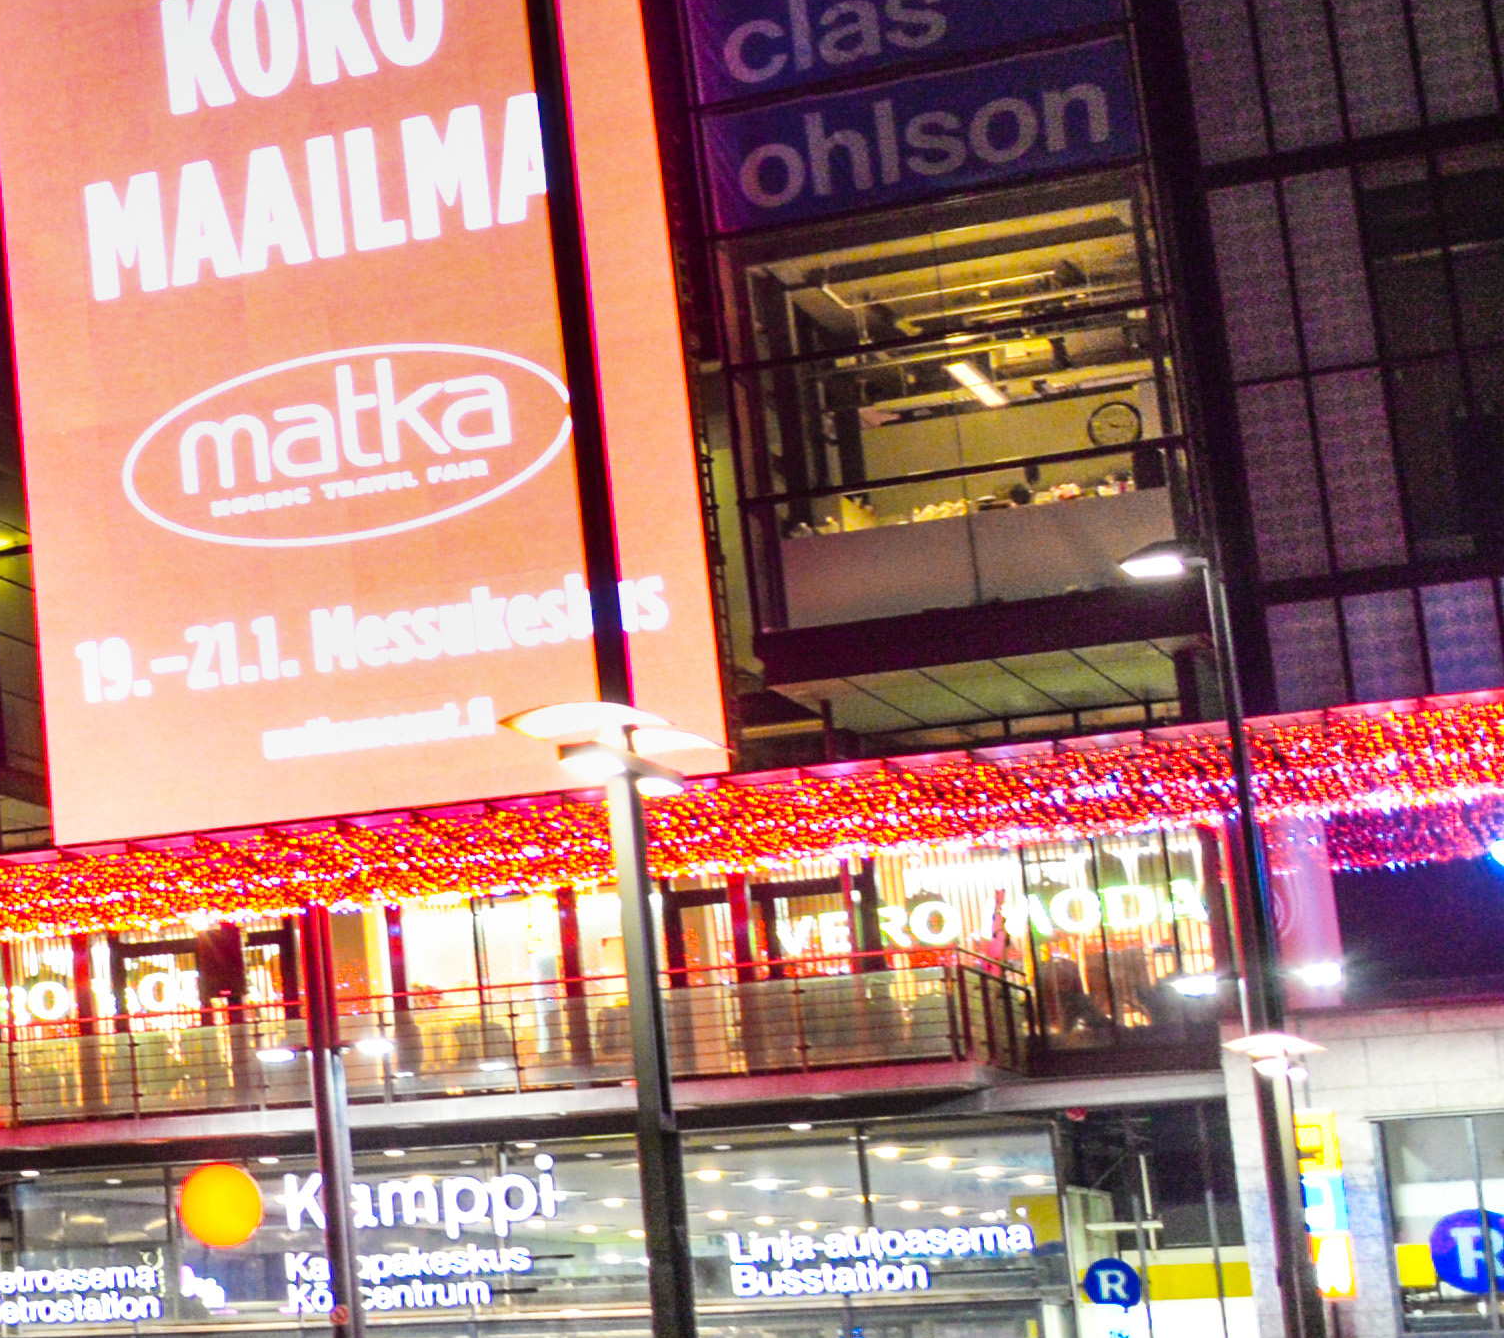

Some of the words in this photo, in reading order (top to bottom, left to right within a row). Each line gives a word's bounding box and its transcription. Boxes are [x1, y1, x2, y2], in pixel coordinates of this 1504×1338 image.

[738, 79, 1111, 210] ohlson
[83, 92, 549, 304] MAAILMA
[177, 356, 515, 498] matka
[319, 470, 420, 501] TRAVEL
[427, 457, 491, 485] FAIR
[774, 901, 961, 959] VERO
[283, 1154, 557, 1240] Kamppi
[726, 1221, 1034, 1266] Linja-autoasema
[730, 1259, 931, 1298] Busstation
[1095, 1268, 1130, 1301] R
